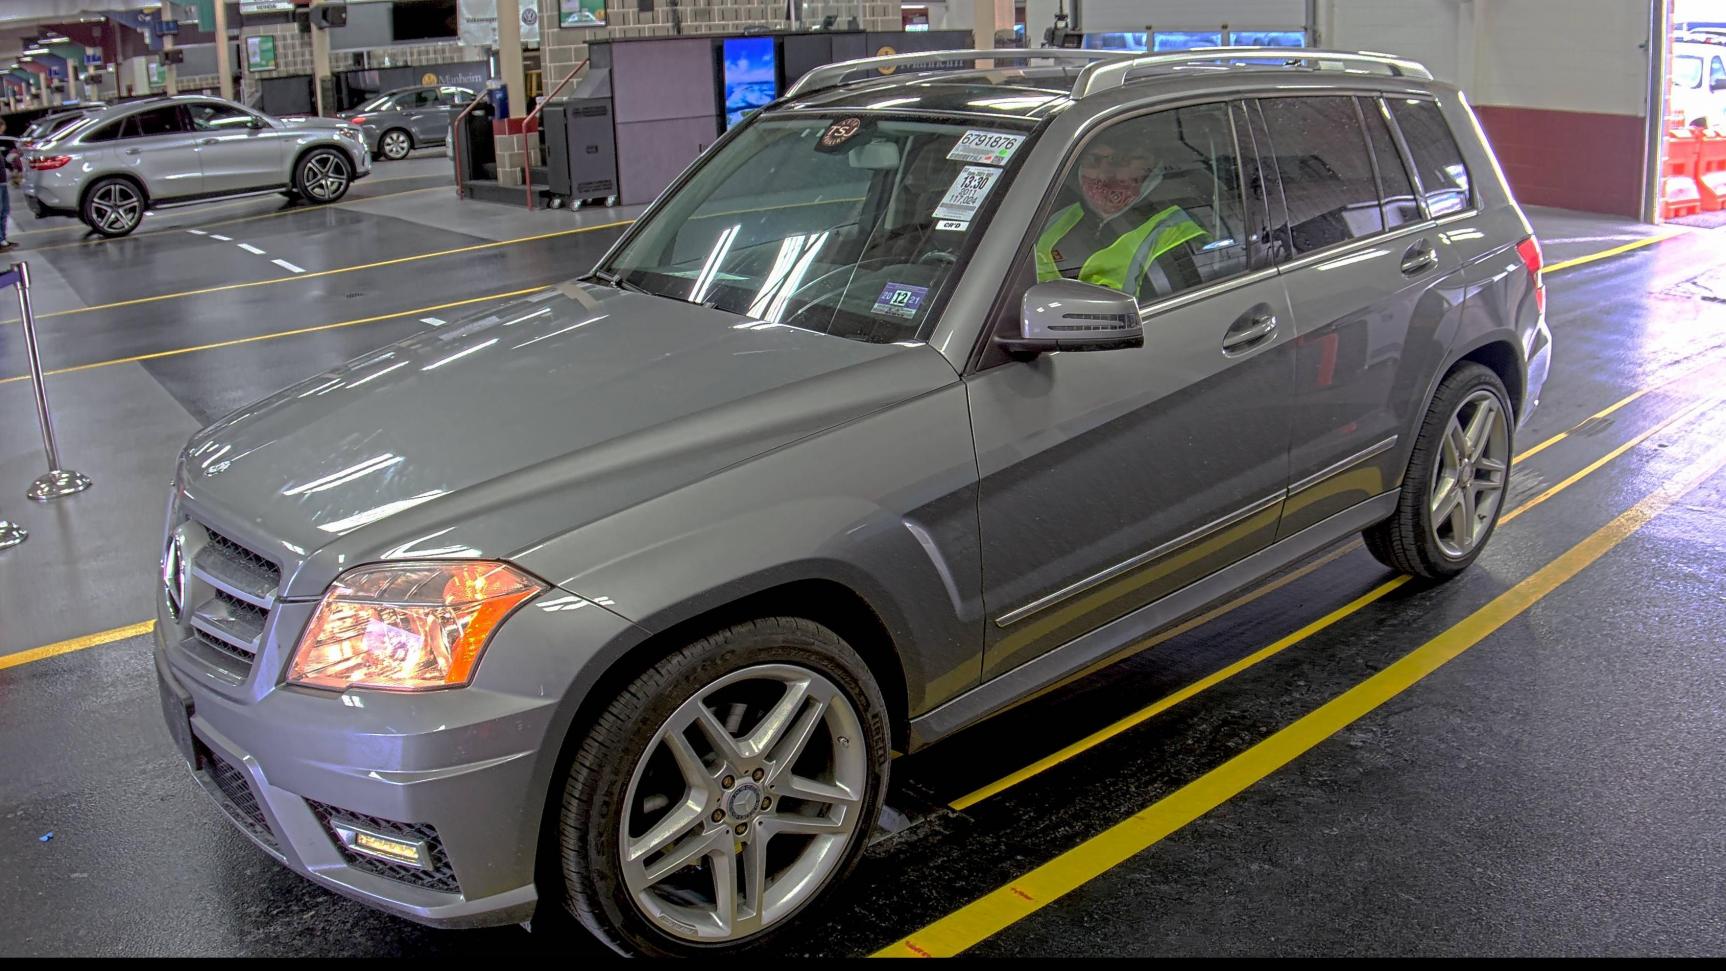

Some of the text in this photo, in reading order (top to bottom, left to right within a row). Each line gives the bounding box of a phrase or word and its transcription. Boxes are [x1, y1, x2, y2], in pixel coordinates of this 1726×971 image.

[439, 73, 481, 84] Manheim
[827, 125, 858, 137] TSJ
[961, 133, 1017, 149] 6791876
[960, 175, 989, 190] 13:30
[958, 188, 977, 196] 2011
[892, 292, 908, 304] 12
[908, 295, 921, 304] 21
